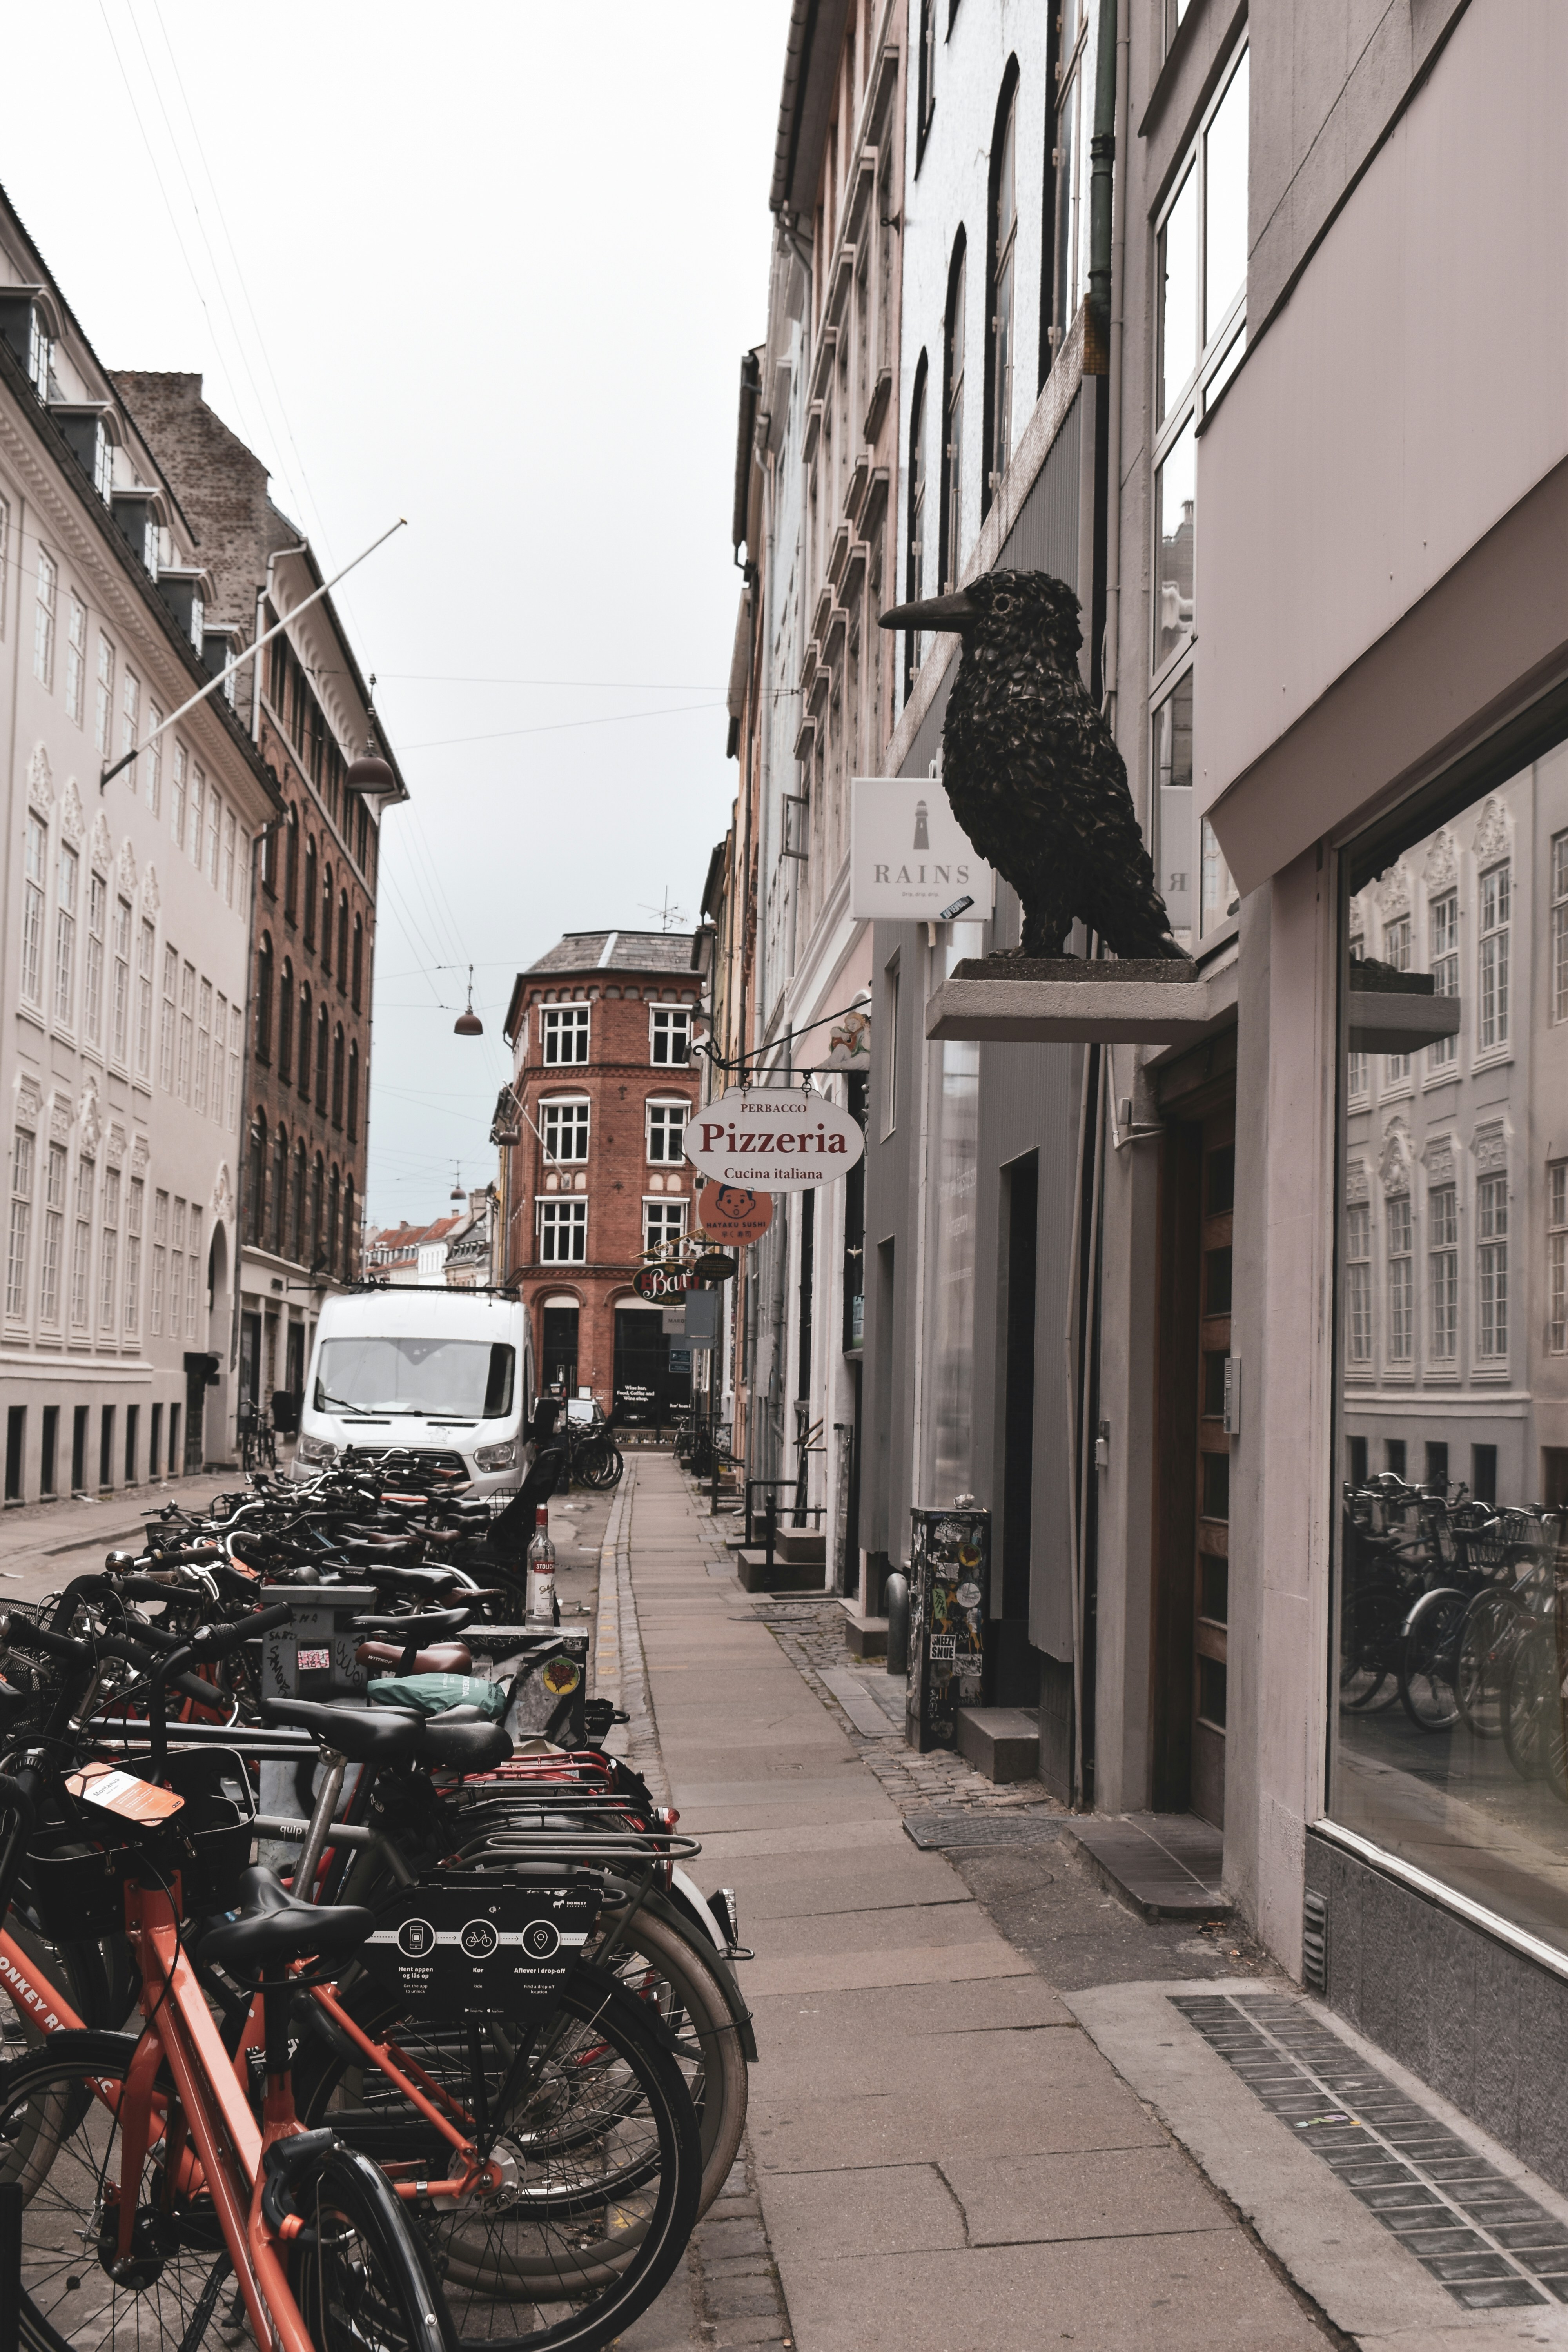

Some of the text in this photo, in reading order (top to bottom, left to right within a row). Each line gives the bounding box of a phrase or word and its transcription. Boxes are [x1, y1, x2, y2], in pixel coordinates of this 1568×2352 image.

[873, 864, 969, 884] RAINS
[740, 1104, 806, 1112] PERBACCO
[699, 1122, 848, 1153] Pizzeria
[724, 1167, 823, 1179] Cucina italiana
[643, 1269, 694, 1299] Bar
[932, 1635, 955, 1646] SNEEZY
[368, 1654, 393, 1664] WITTKOP
[932, 1647, 954, 1658] SNUE
[93, 1777, 120, 1797] Montanus
[280, 1825, 302, 1841] quip
